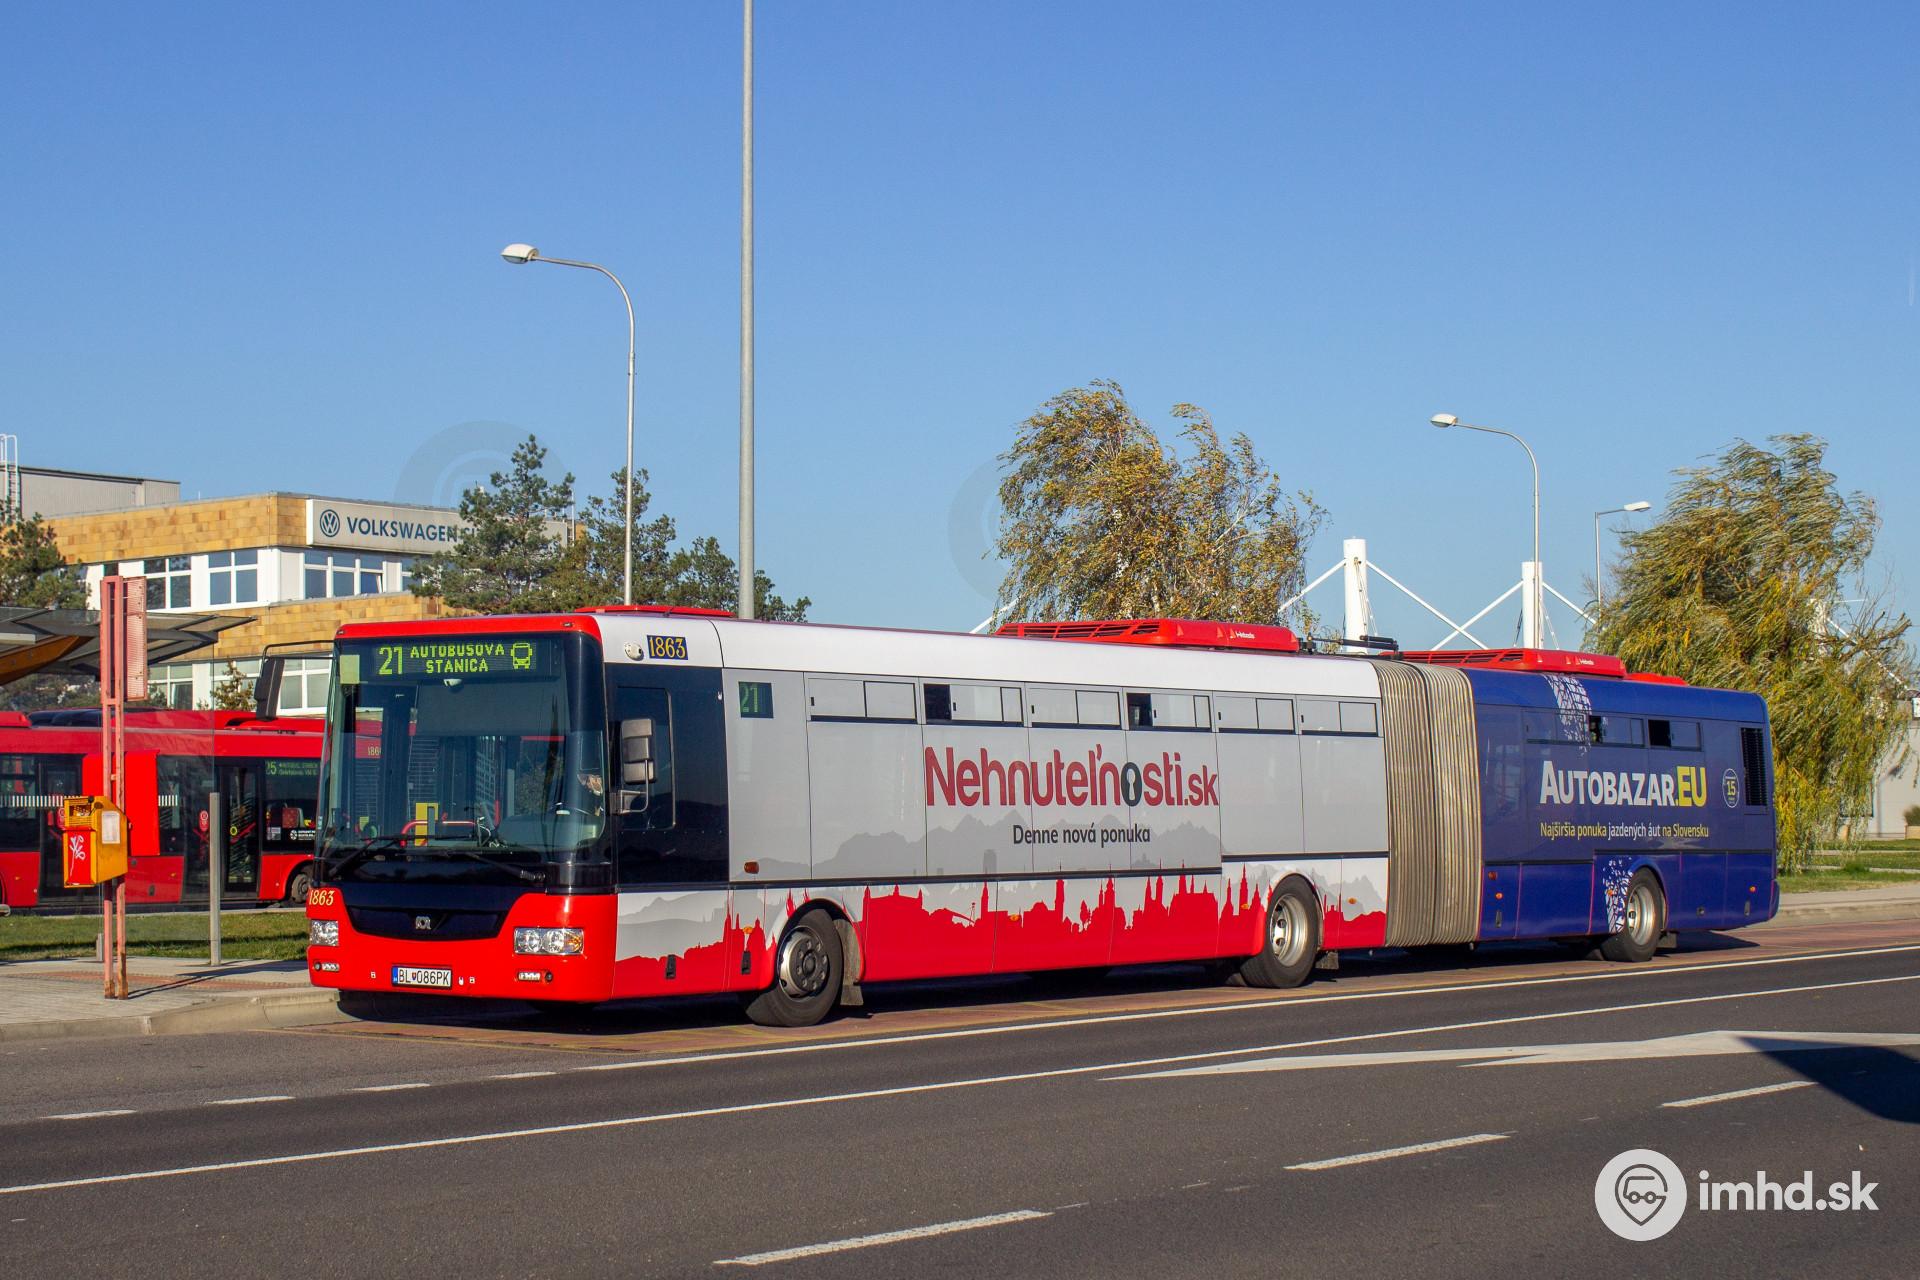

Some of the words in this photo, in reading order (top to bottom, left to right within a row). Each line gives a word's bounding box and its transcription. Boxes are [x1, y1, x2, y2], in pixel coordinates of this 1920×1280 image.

[347, 516, 458, 542] VOLKSWAGEN
[378, 646, 403, 675] 21
[410, 643, 505, 658] AUTOBUSOVA
[649, 637, 686, 659] 1863
[426, 658, 489, 673] STANICA
[740, 683, 758, 713] 21
[924, 743, 1219, 807] Nehnuteľnosti.sk
[1540, 760, 1708, 807] AUTOBAZAR.EU
[1727, 780, 1736, 796] 15
[1013, 824, 1058, 844] Denne
[1063, 823, 1096, 844] nová
[1101, 823, 1150, 848] ponuka
[1540, 822, 1575, 840] Najširšia
[1577, 822, 1607, 840] ponuka
[1608, 822, 1646, 840] jazdených
[1648, 822, 1661, 837] áut
[1663, 825, 1671, 837] na
[1673, 823, 1709, 838] Slovensku
[309, 888, 335, 906] 1863
[399, 969, 411, 983] BL
[416, 970, 450, 985] 086PK
